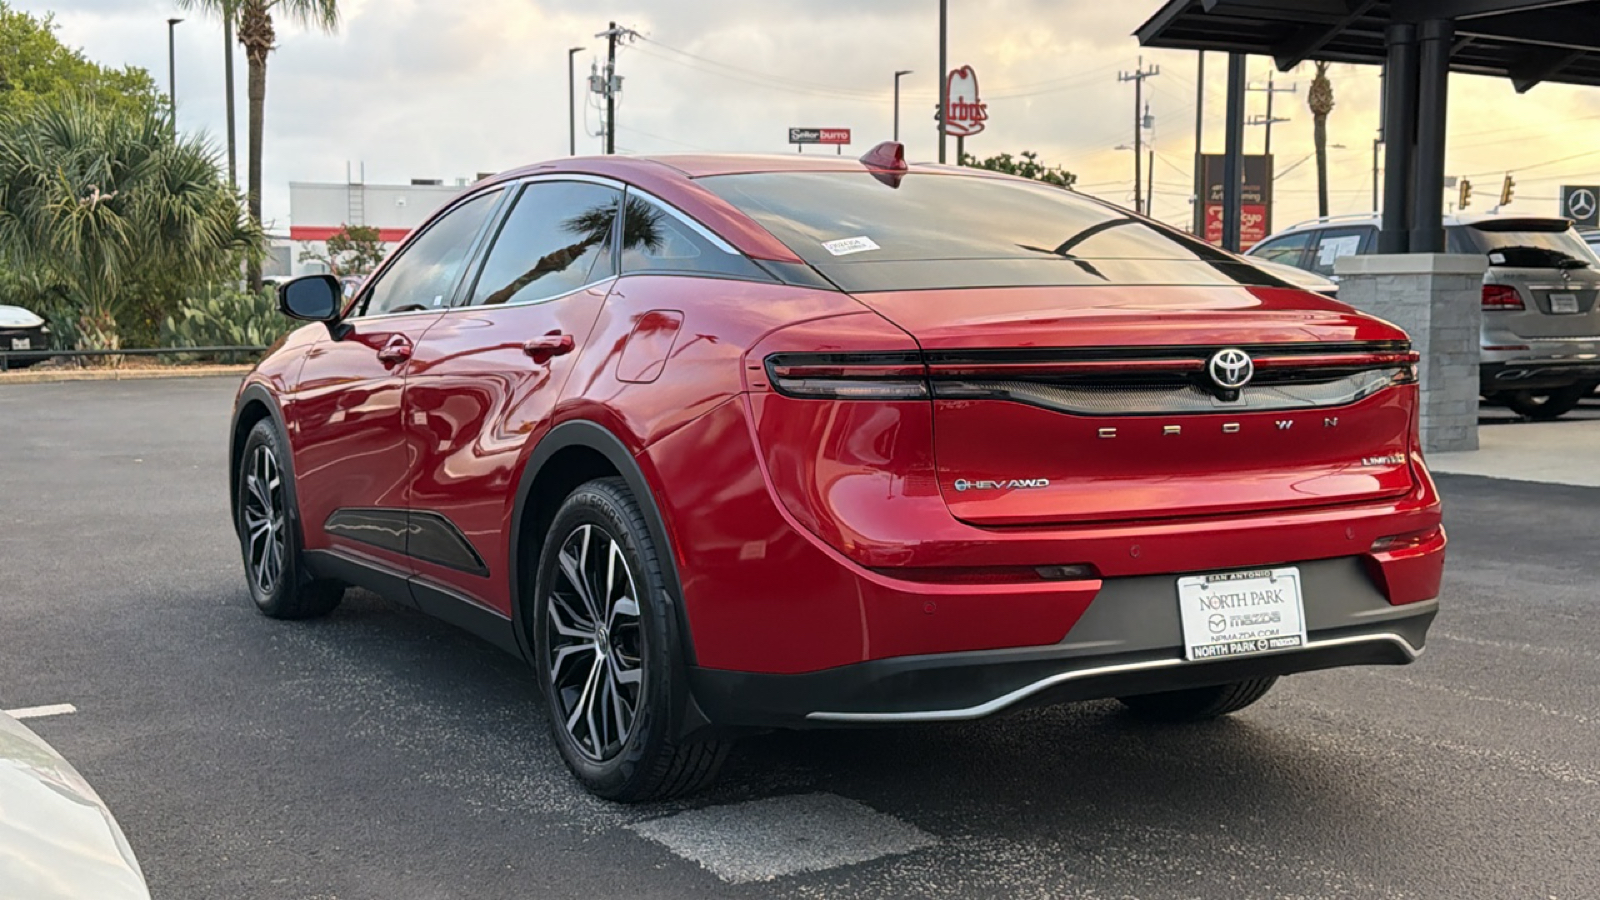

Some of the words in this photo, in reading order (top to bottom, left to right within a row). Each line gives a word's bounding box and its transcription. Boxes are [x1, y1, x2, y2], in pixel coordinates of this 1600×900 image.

[820, 130, 849, 140] burro
[1098, 417, 1339, 438] CROWN
[1208, 574, 1227, 582] SAN
[1229, 570, 1272, 581] ANTONIO
[1199, 592, 1249, 611] NORTH
[1250, 588, 1284, 607] PARK
[1194, 643, 1229, 657] NORTH
[1230, 639, 1257, 654] PARK
